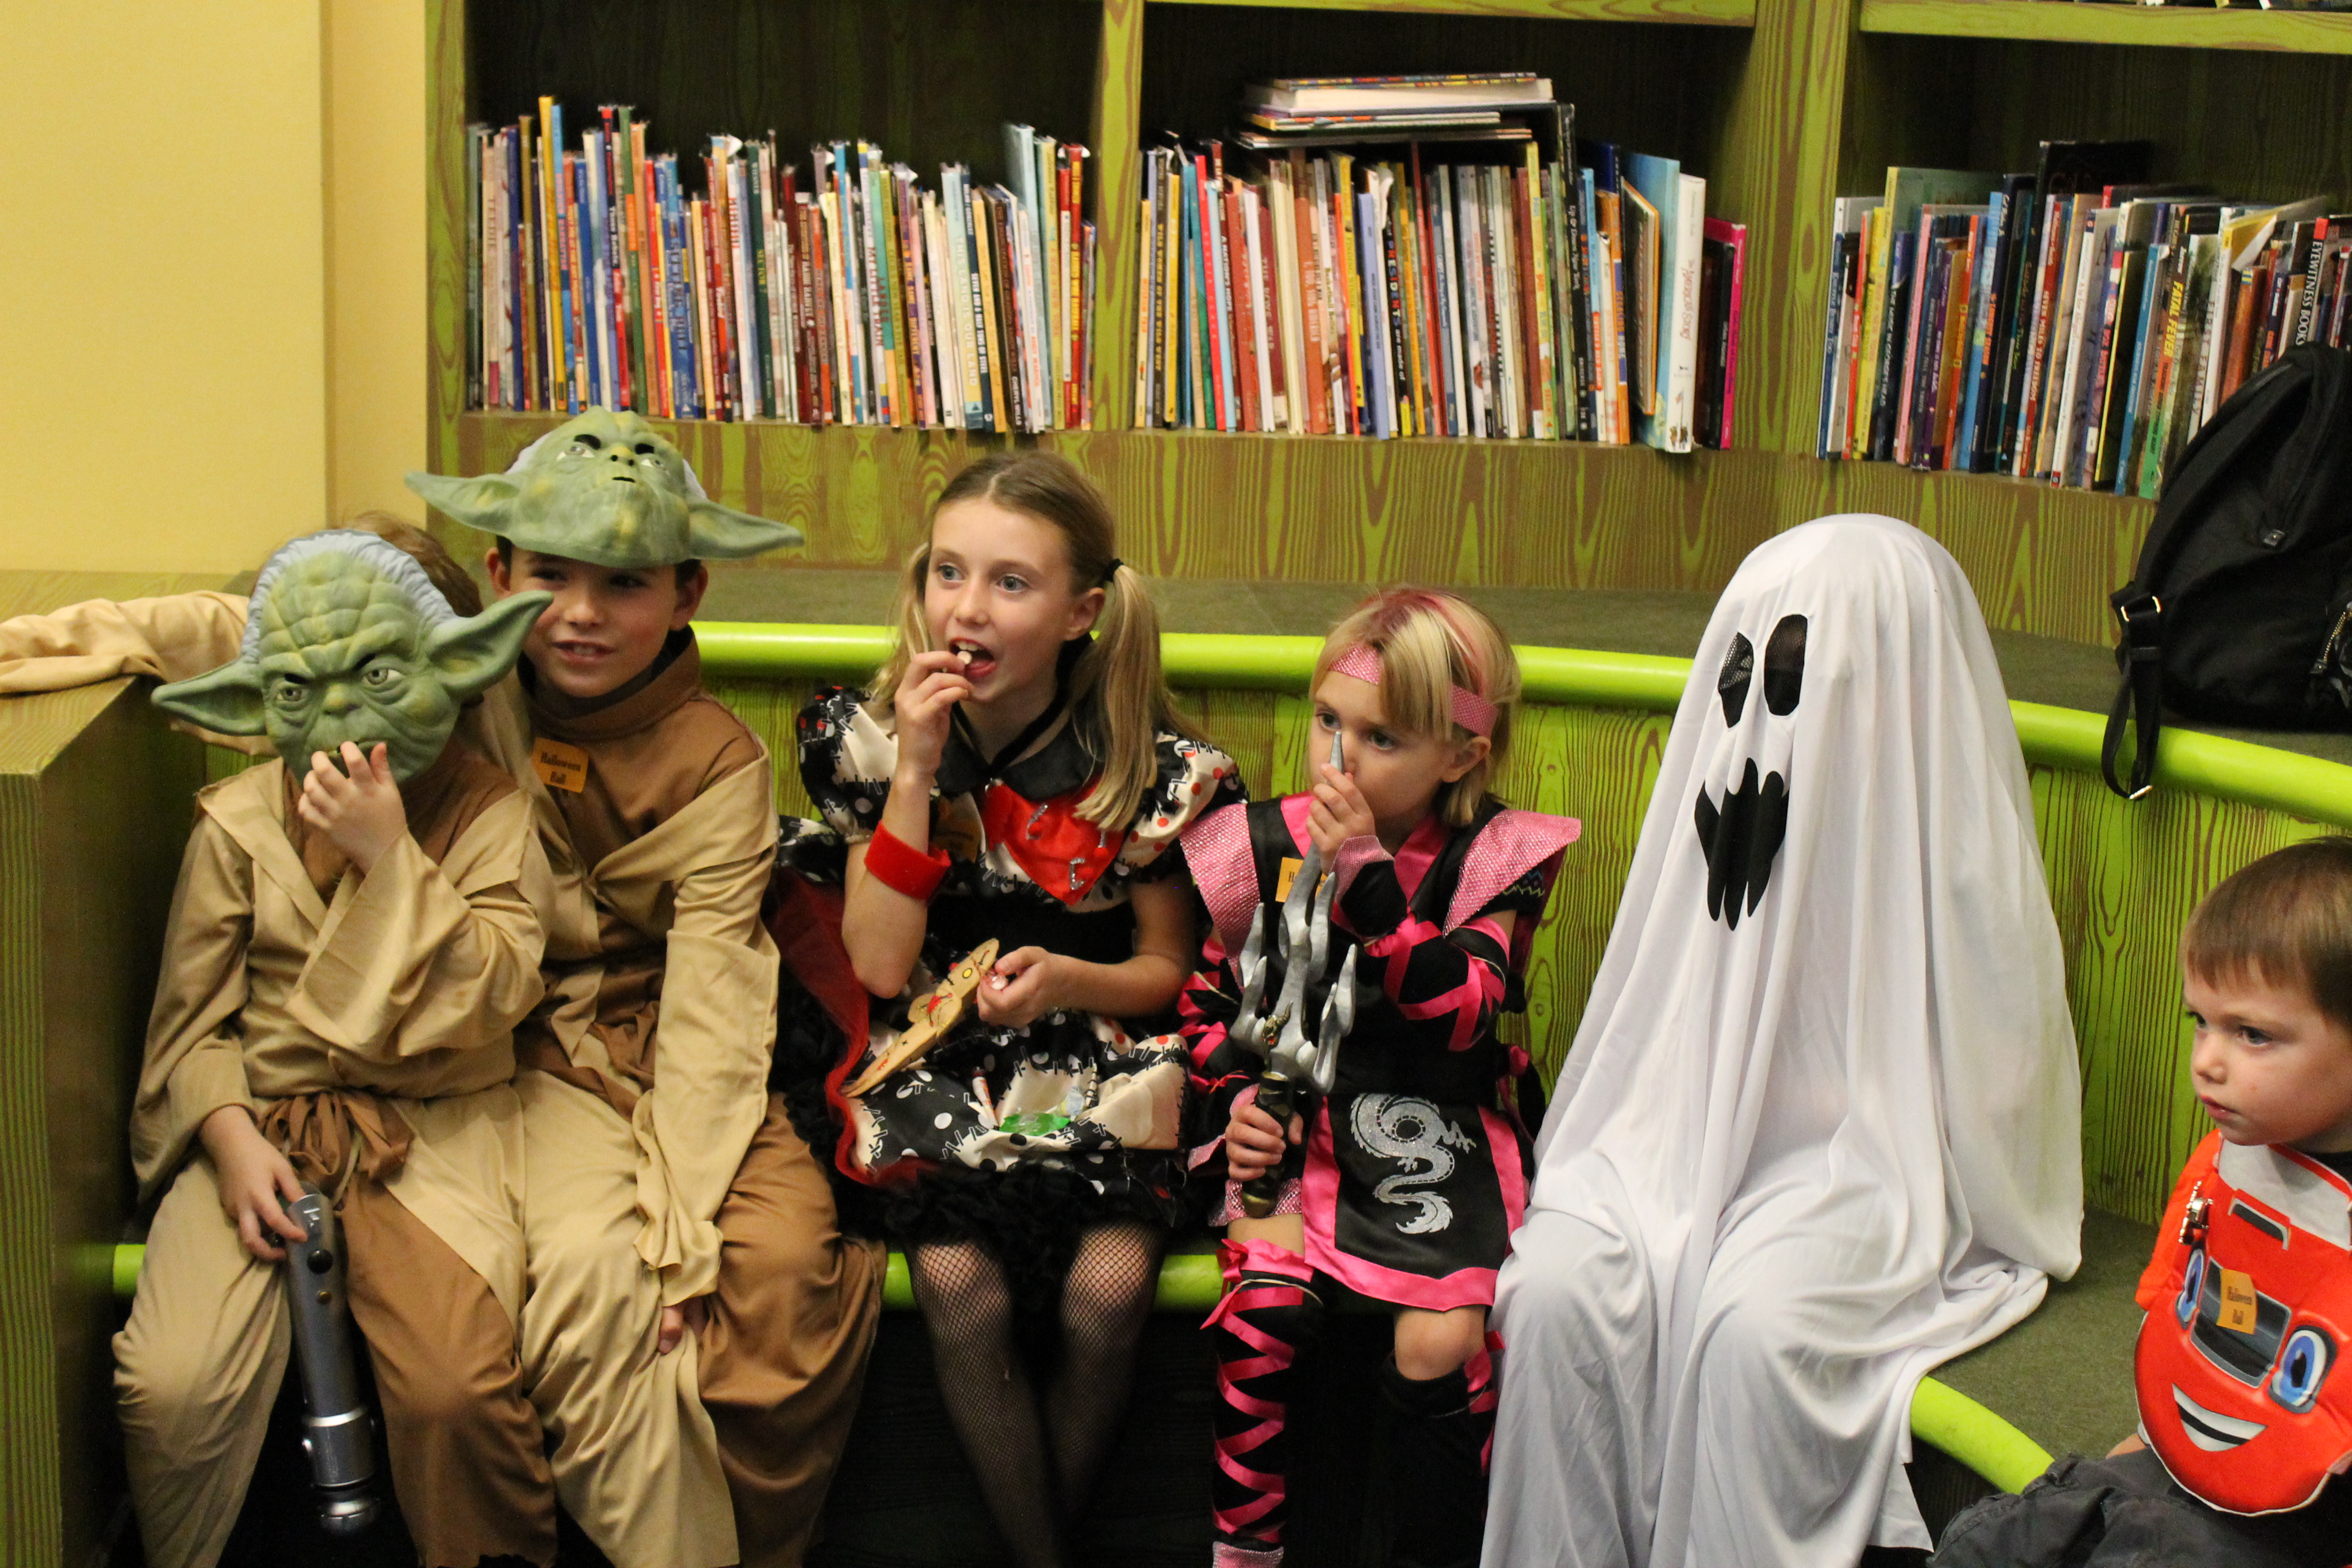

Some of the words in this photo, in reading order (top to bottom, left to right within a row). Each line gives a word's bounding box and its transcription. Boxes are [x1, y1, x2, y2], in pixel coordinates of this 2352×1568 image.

[1567, 205, 1576, 216] Up
[955, 236, 965, 265] THIS
[957, 269, 968, 302] LAND
[971, 273, 979, 292] SEVEN
[1386, 240, 1401, 326] PRESIDENTS
[2301, 240, 2323, 307] EYEWITNESS
[869, 268, 879, 307] LITTLE
[973, 293, 981, 306] AND
[2168, 281, 2184, 318] FATAL
[962, 307, 970, 317] IS
[2040, 290, 2050, 317] SEVEN
[873, 312, 883, 347] TRAIN
[974, 313, 983, 329] HALF
[2036, 318, 2046, 345] MILES
[2294, 308, 2311, 346] BOOKS
[963, 323, 974, 348] OUR
[976, 330, 985, 345] TONS
[2163, 318, 2179, 358] FEVER
[979, 356, 988, 373] STEEL
[1396, 345, 1404, 369] made
[2034, 347, 2042, 358] TO
[966, 352, 978, 386] LAND
[1398, 372, 1406, 382] of
[2029, 360, 2041, 401] FREEDOM
[1011, 376, 1019, 404] CHERYL
[541, 752, 581, 772] Halloween
[2227, 1286, 2252, 1305] Halloween
